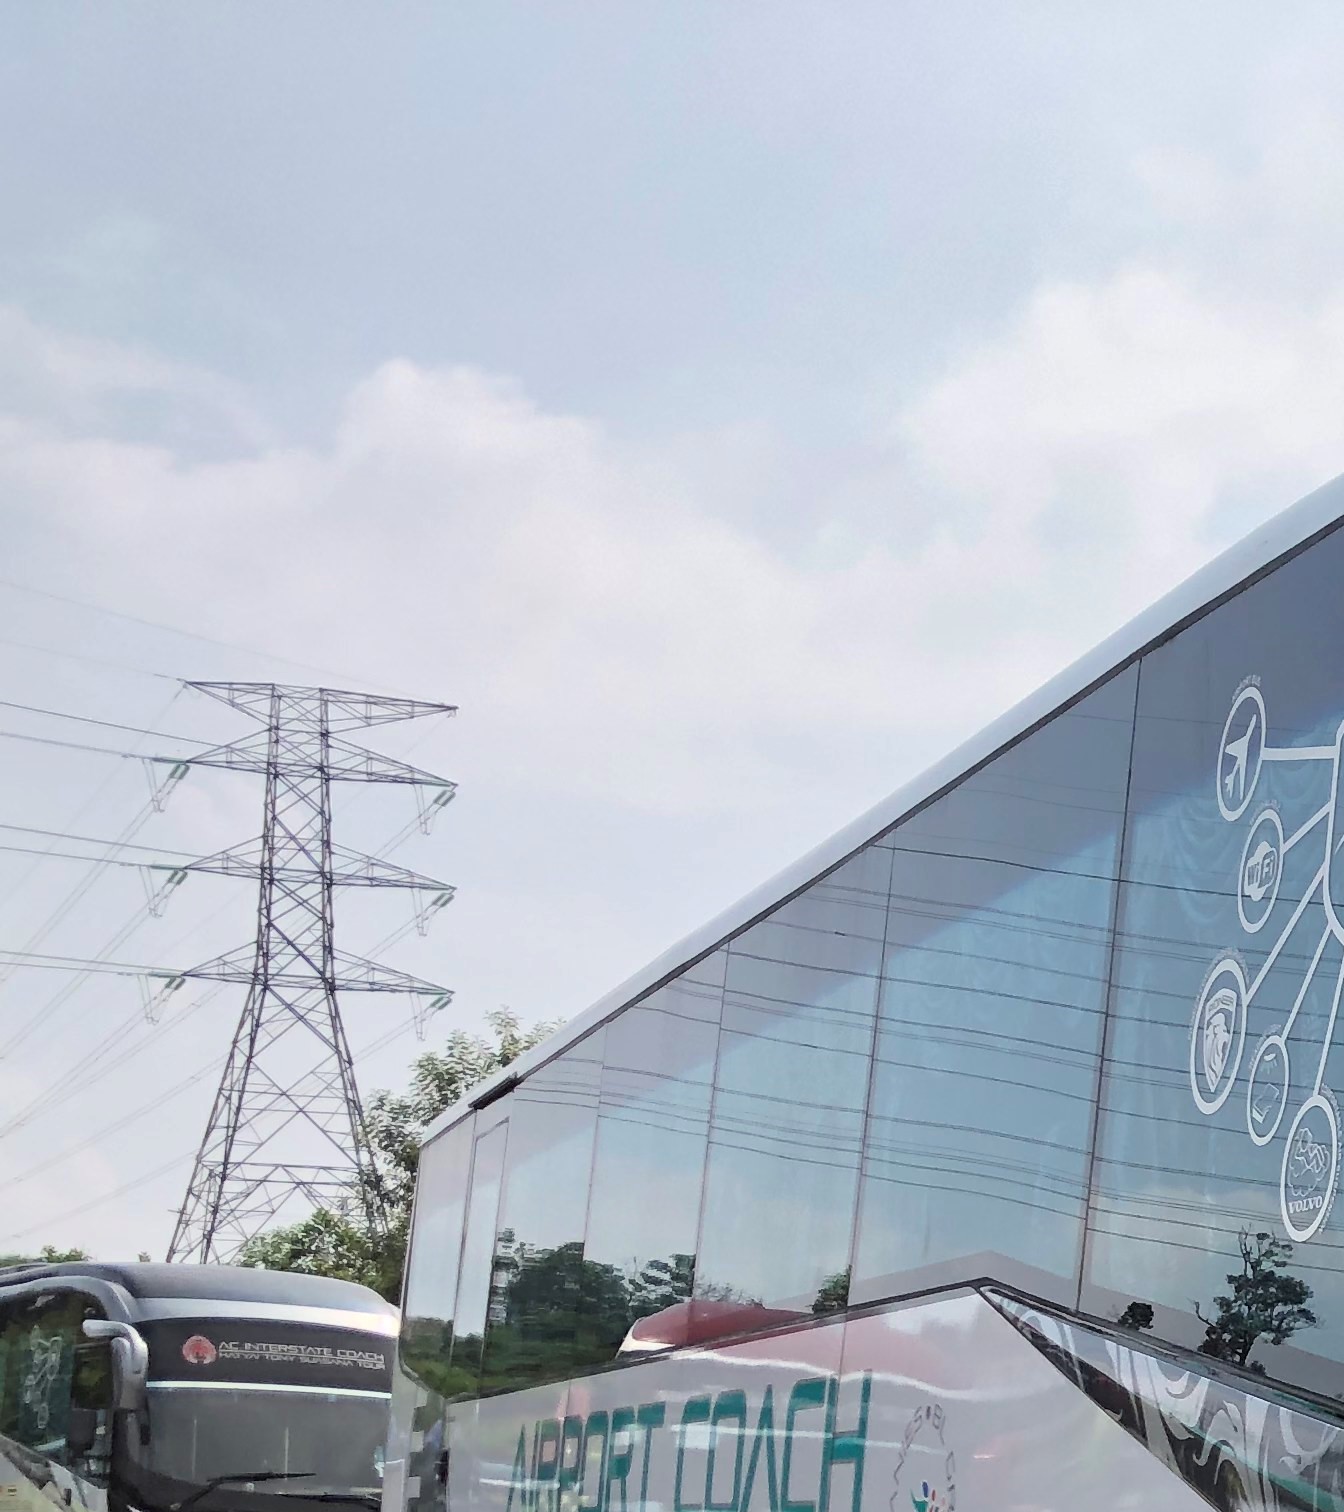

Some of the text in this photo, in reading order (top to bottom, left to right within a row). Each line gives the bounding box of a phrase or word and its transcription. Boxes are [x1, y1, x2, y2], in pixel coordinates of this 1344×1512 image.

[1288, 1195, 1323, 1214] VOLVO
[244, 1342, 333, 1357] INTERSTATE
[336, 1348, 384, 1363] COACH
